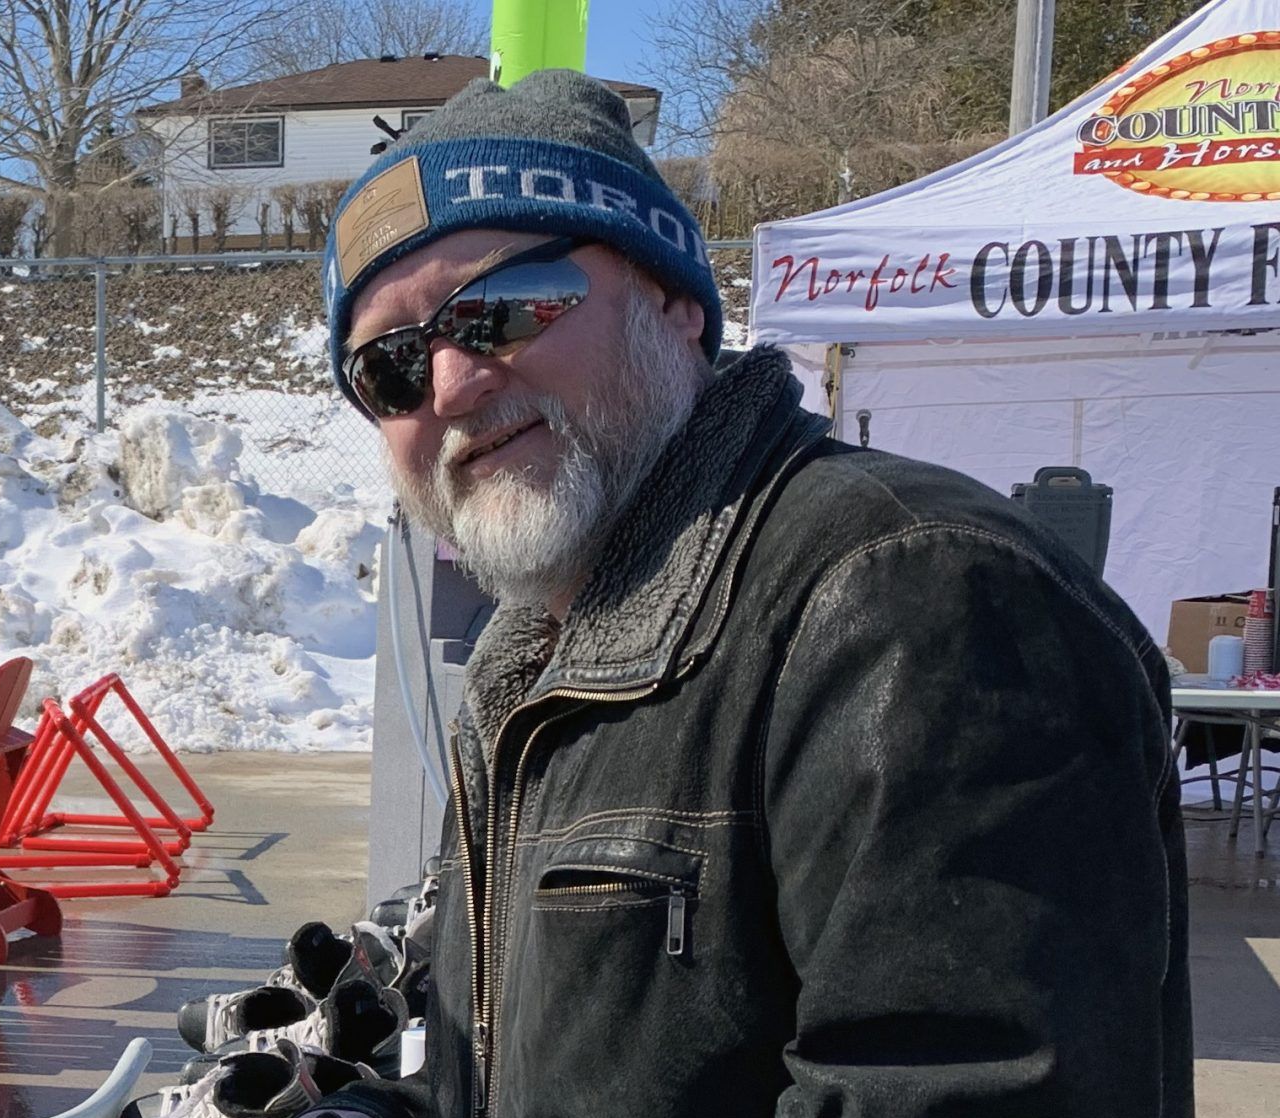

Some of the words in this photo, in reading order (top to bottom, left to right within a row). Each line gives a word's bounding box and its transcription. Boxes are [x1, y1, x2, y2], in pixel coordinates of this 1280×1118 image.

[1083, 152, 1144, 171] and
[1156, 139, 1280, 171] Hors
[772, 252, 958, 311] Norfolk
[970, 227, 1225, 318] COUNTY
